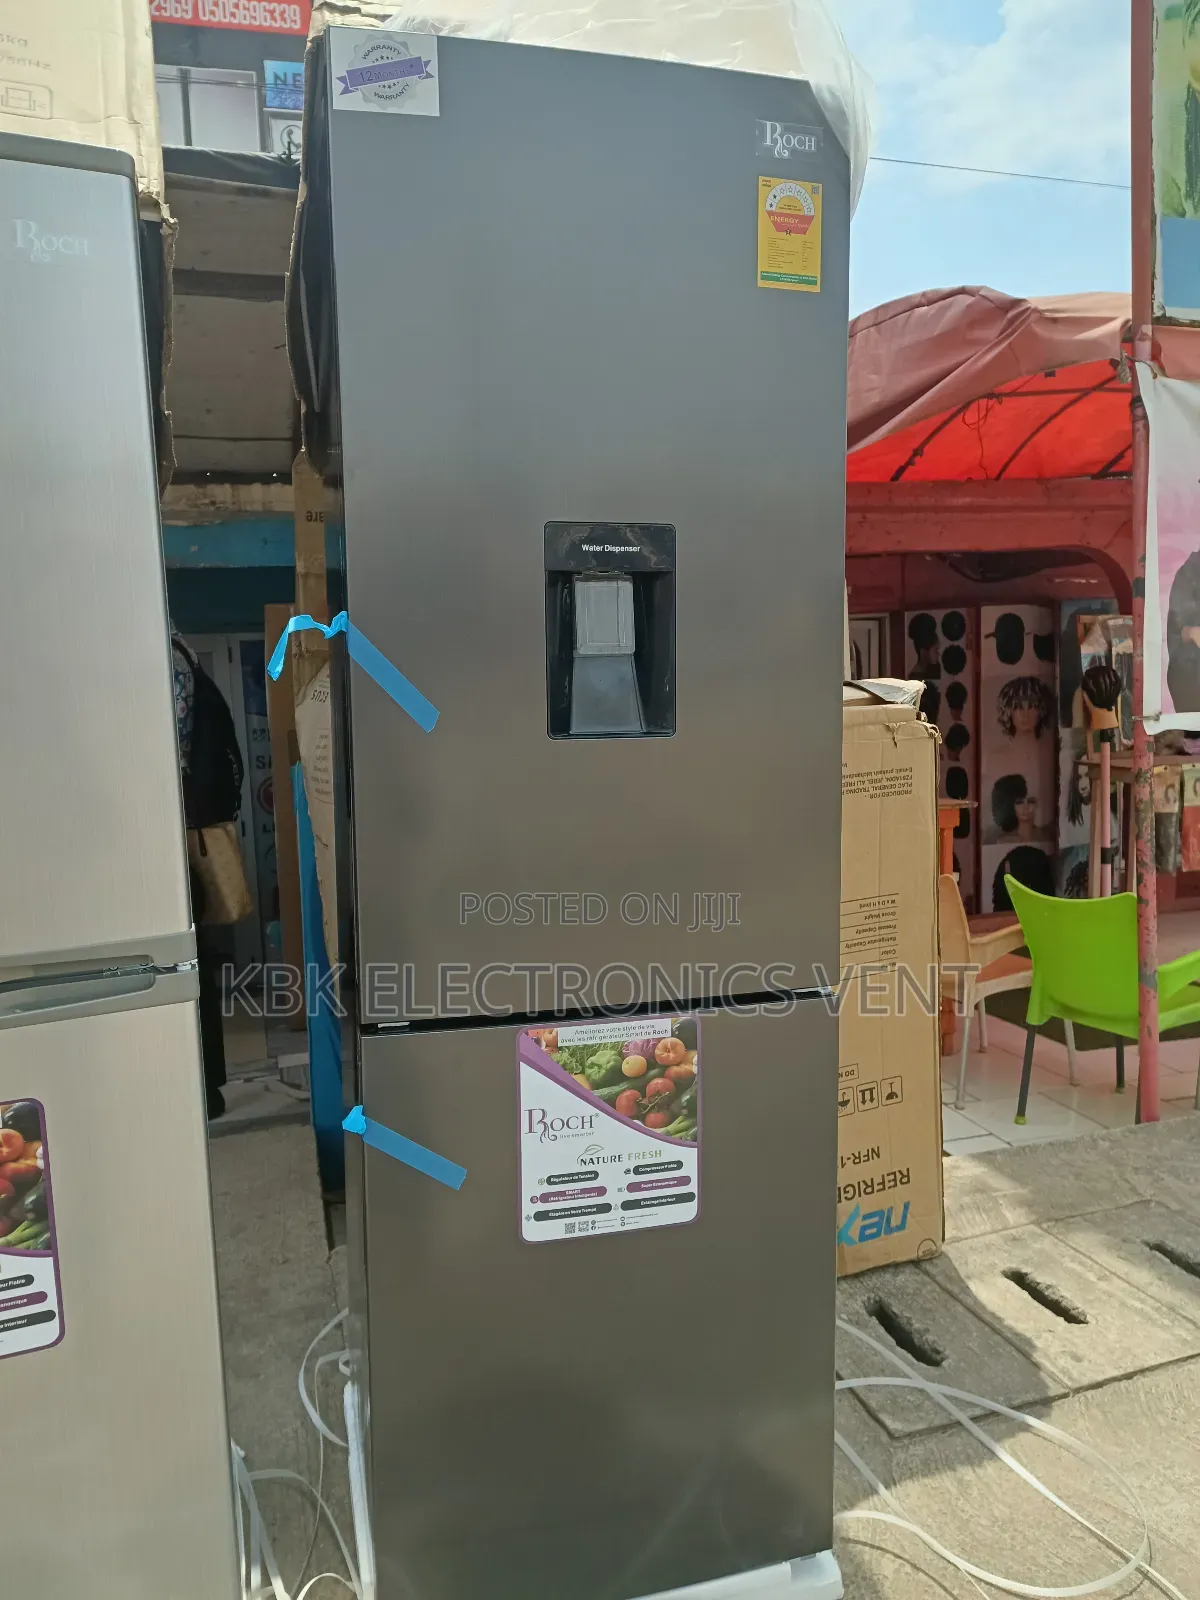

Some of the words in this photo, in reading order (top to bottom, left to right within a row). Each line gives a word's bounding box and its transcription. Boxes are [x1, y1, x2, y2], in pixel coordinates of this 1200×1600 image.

[198, 0, 301, 29] 0505696339
[362, 44, 401, 60] WARRANTY
[374, 82, 410, 100] WARRANTY
[770, 215, 799, 224] ENERGY
[581, 544, 604, 552] Water
[604, 544, 641, 553] Dispenser
[845, 786, 870, 795] TRADING
[881, 789, 912, 798] PRODUCED
[605, 1025, 622, 1033] votre
[622, 1024, 636, 1033] style
[560, 1036, 575, 1044] avec
[625, 1030, 643, 1038] Smart
[652, 1028, 669, 1036] Roch
[845, 1069, 855, 1077] DO
[580, 1154, 624, 1166] NATURE
[627, 1150, 662, 1161] FRESH
[838, 1146, 881, 1169] NFR-1
